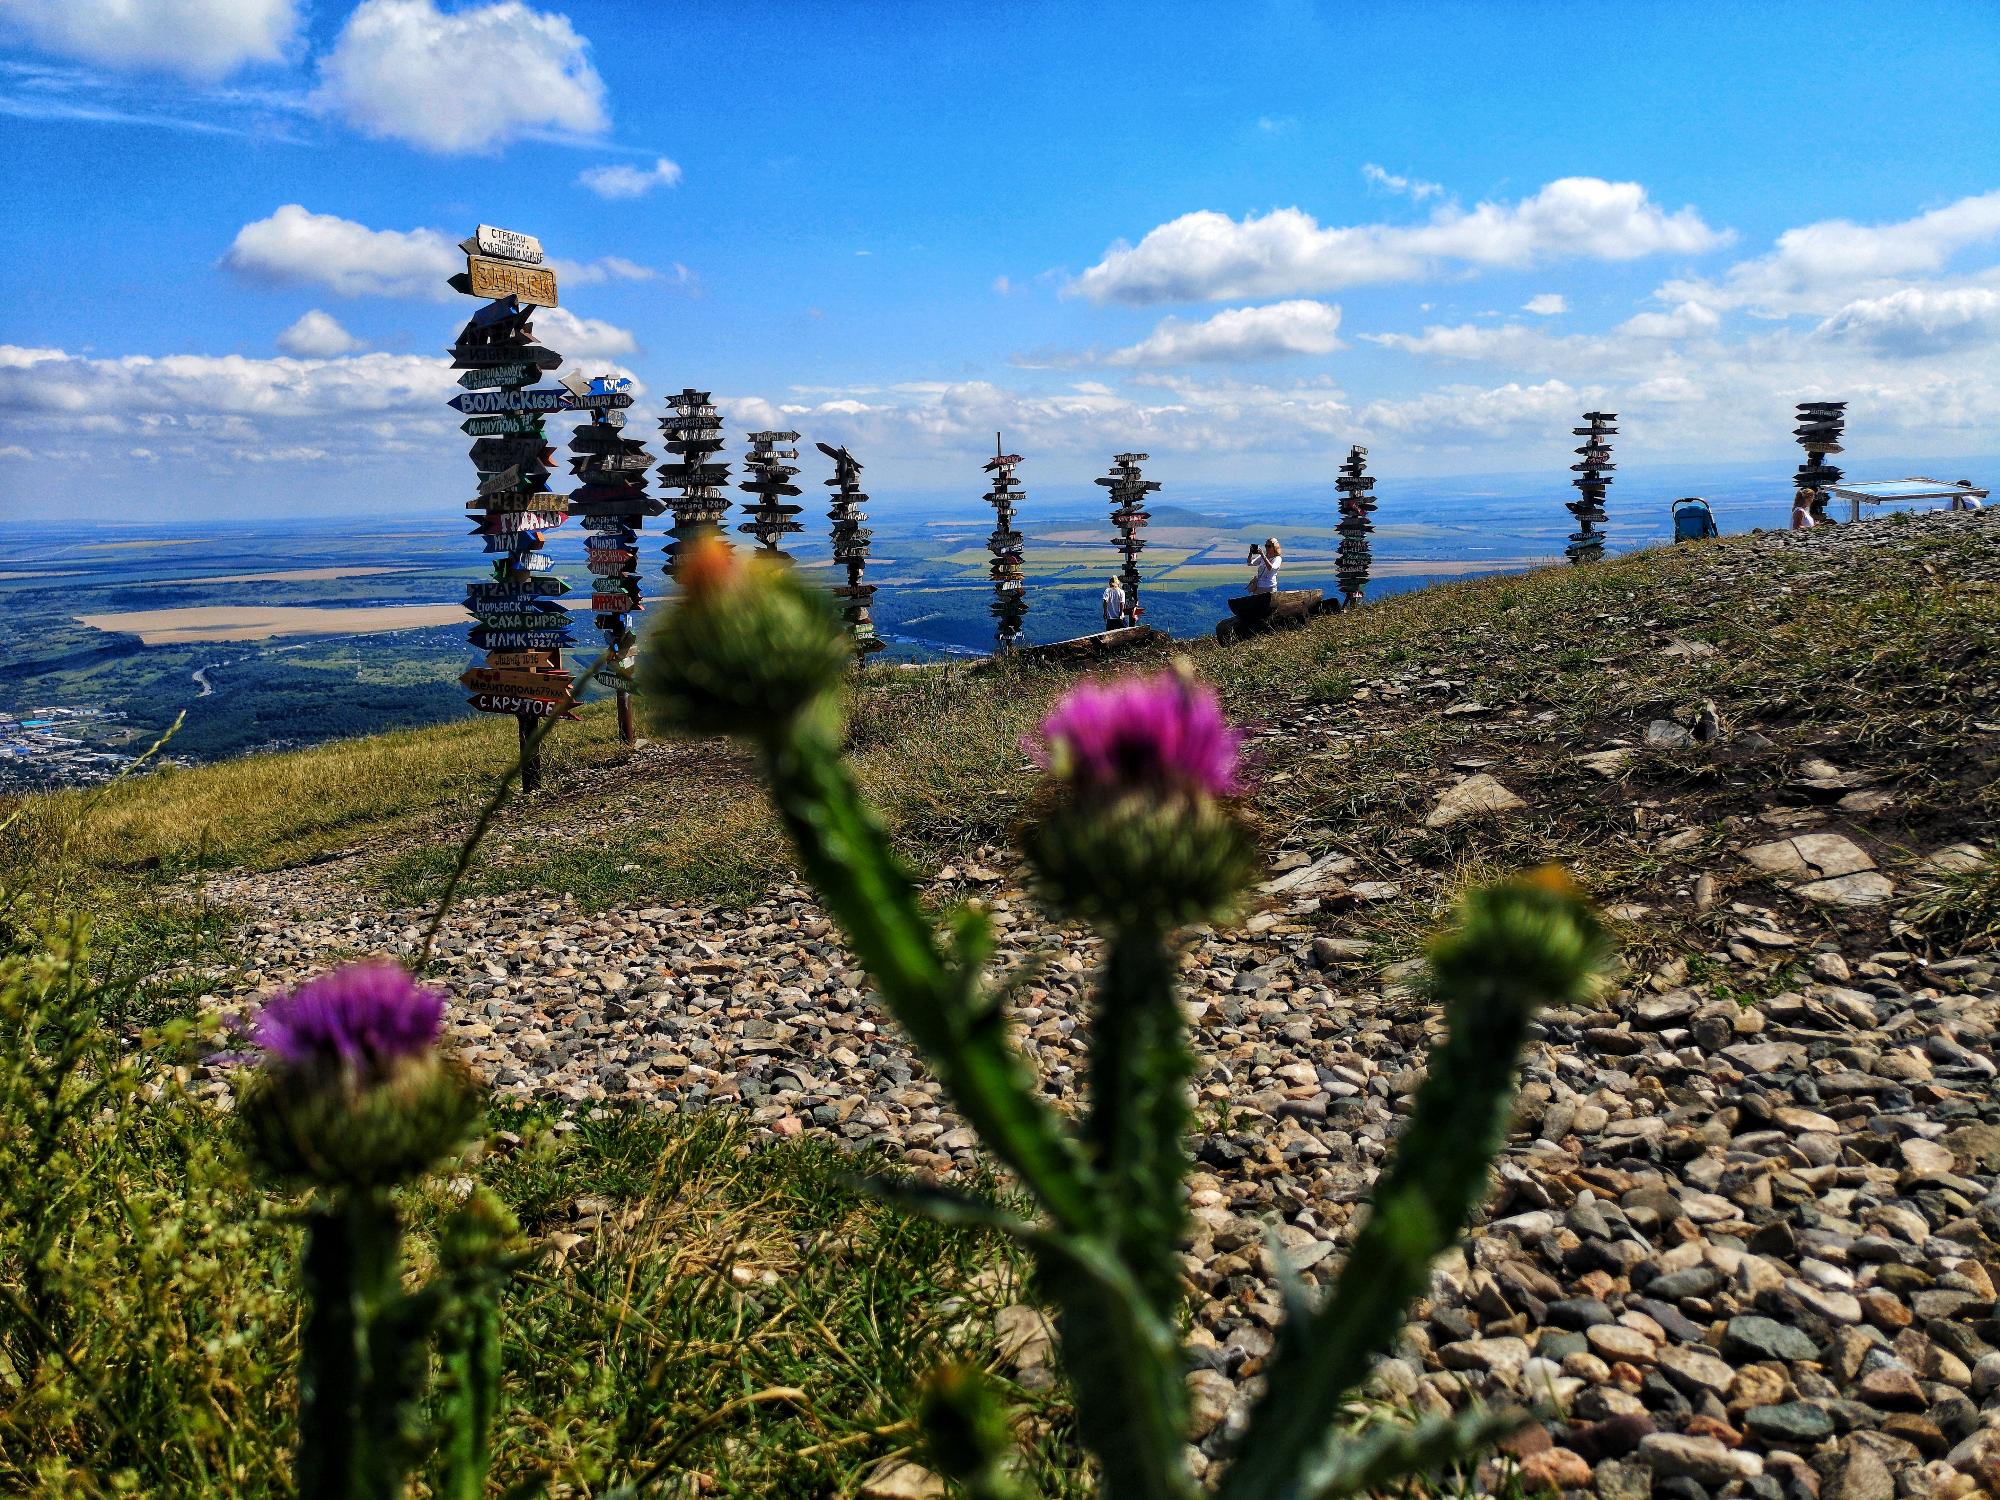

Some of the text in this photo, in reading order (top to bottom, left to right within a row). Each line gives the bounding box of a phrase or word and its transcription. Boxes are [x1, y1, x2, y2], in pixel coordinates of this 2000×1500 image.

[491, 228, 527, 244] СТРЕЛКИ
[460, 391, 532, 413] ВОЛЖСК
[487, 615, 522, 629] САХА
[485, 632, 527, 648] НЛМК
